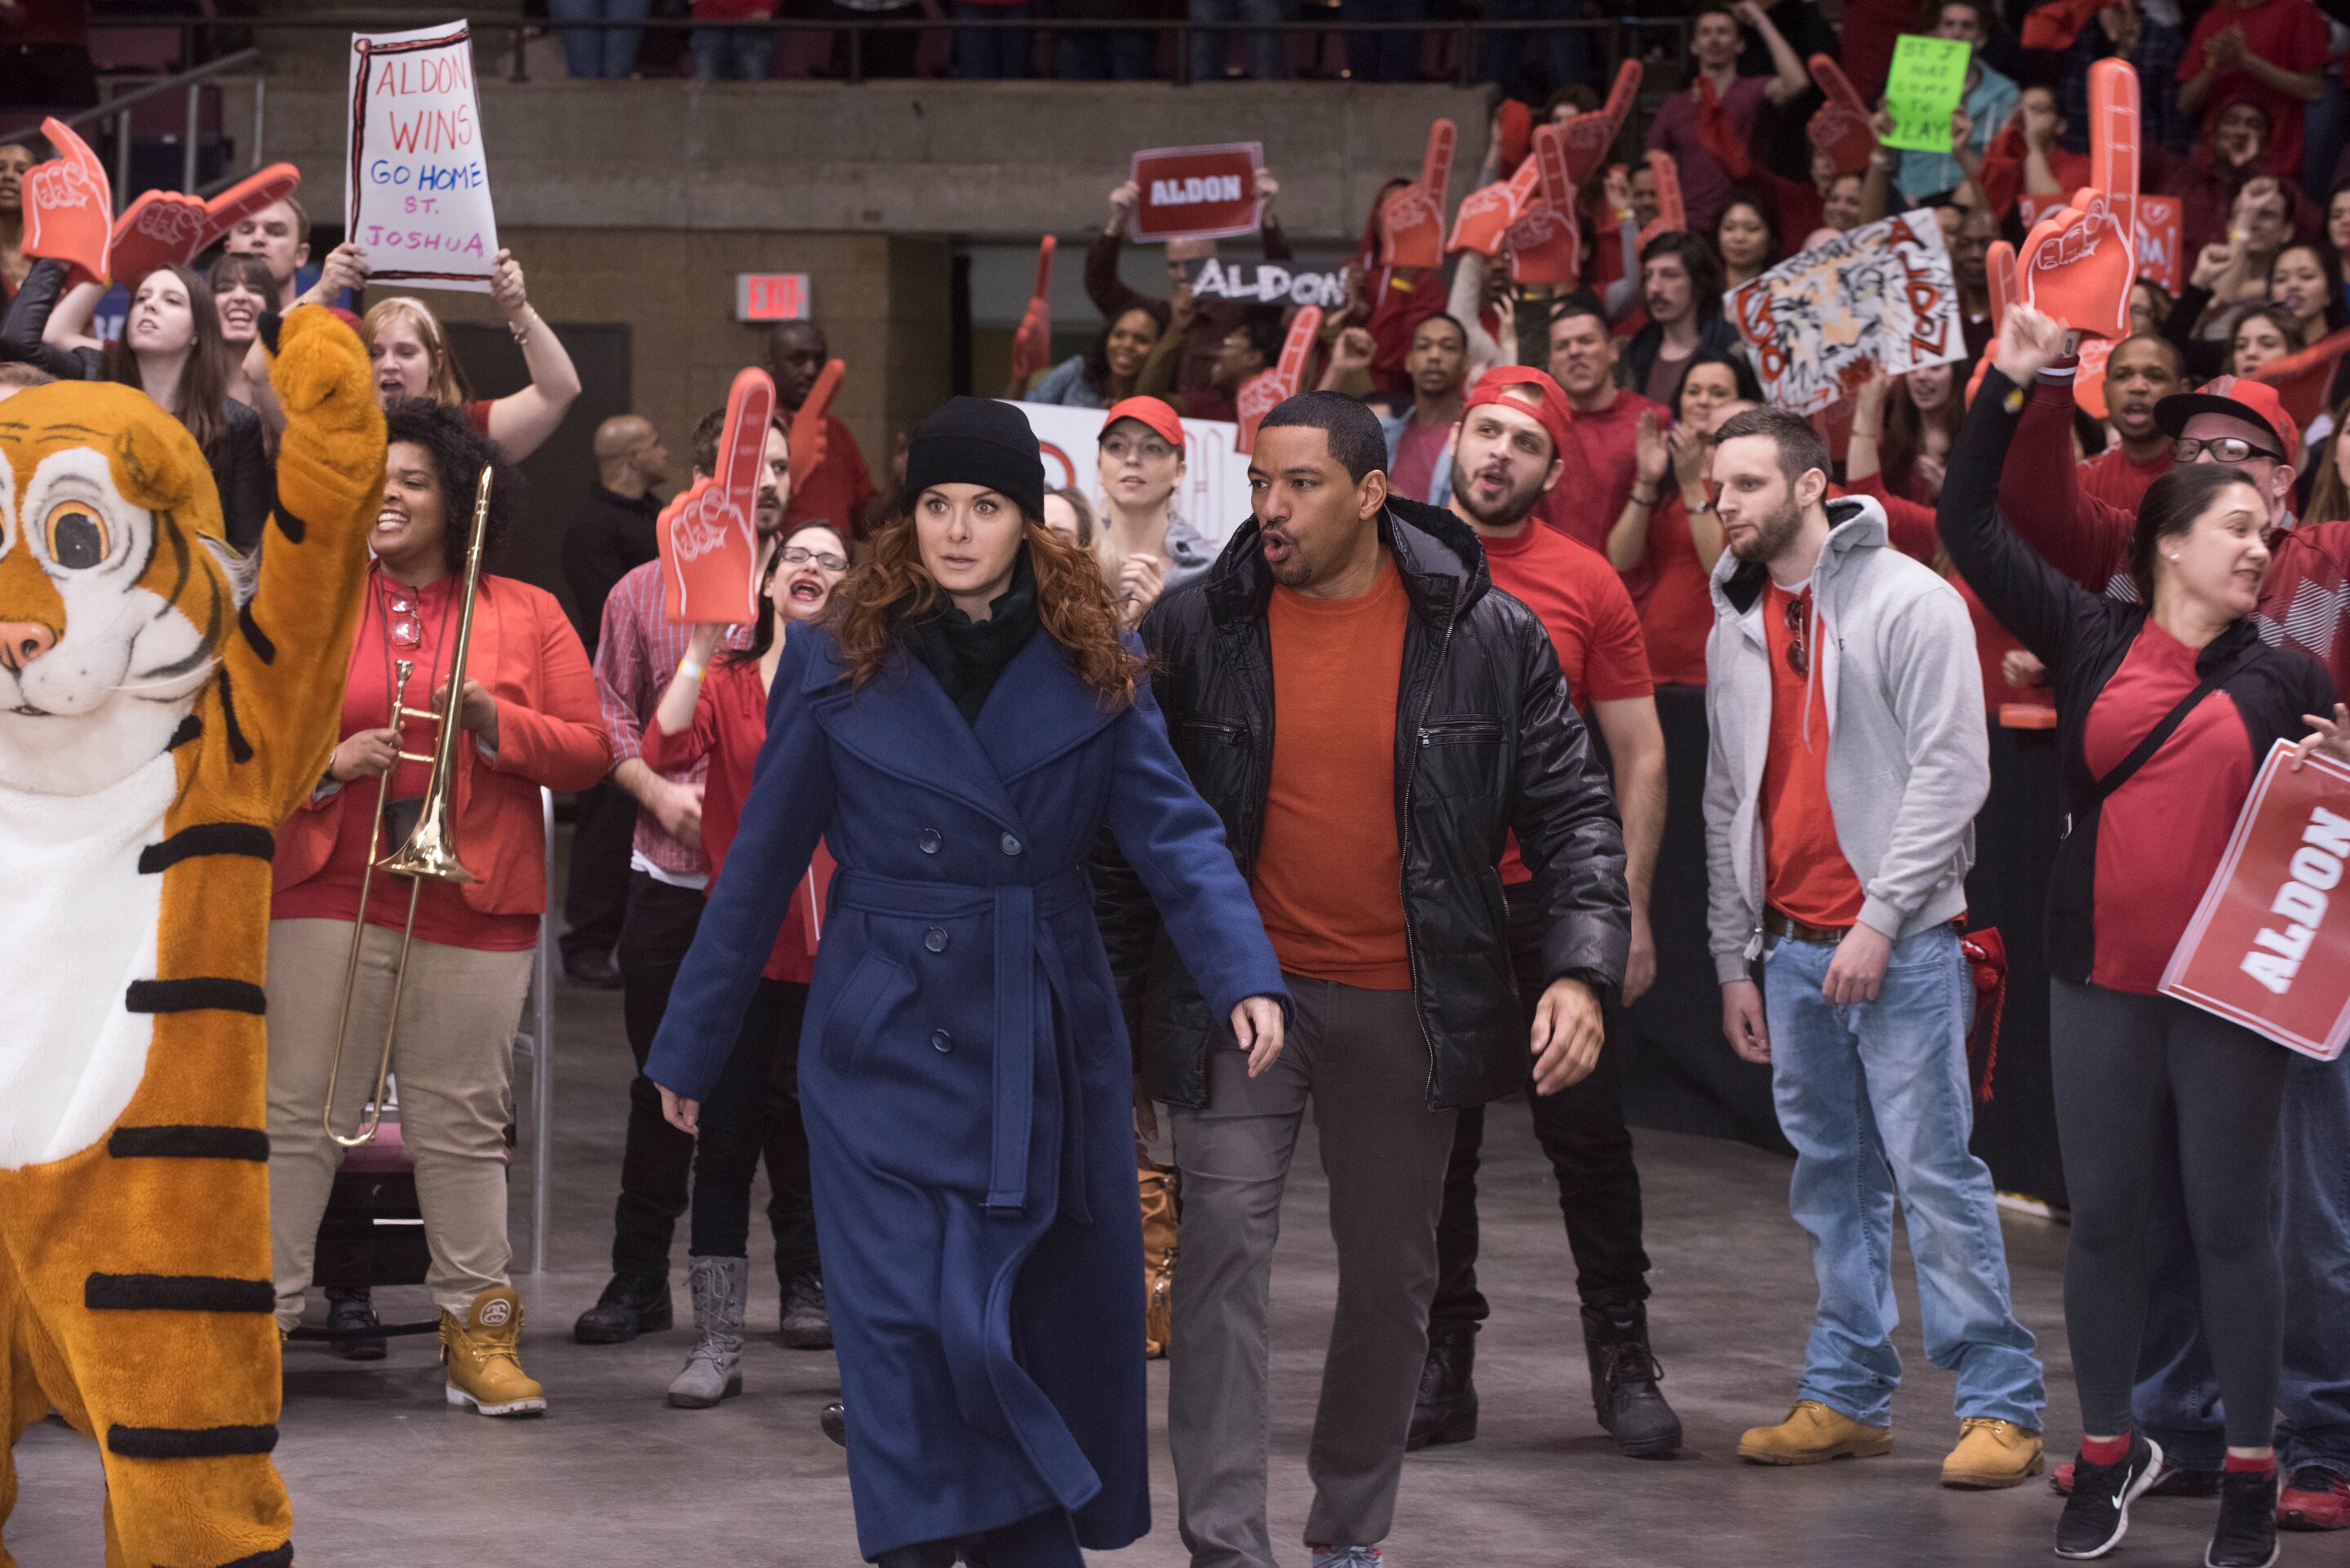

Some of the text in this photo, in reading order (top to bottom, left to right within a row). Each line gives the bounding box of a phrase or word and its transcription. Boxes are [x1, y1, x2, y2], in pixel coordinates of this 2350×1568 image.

[375, 46, 468, 98] ALDON
[389, 104, 472, 154] WINS
[1900, 119, 1949, 145] LAY
[370, 159, 483, 191] GO HOME
[1151, 175, 1241, 206] ALDON
[405, 196, 439, 215] ST.
[366, 224, 484, 258] JOSHUA
[748, 277, 797, 319] EXIT
[1192, 257, 1350, 307] ALDON
[2238, 805, 2350, 994] ALDON
